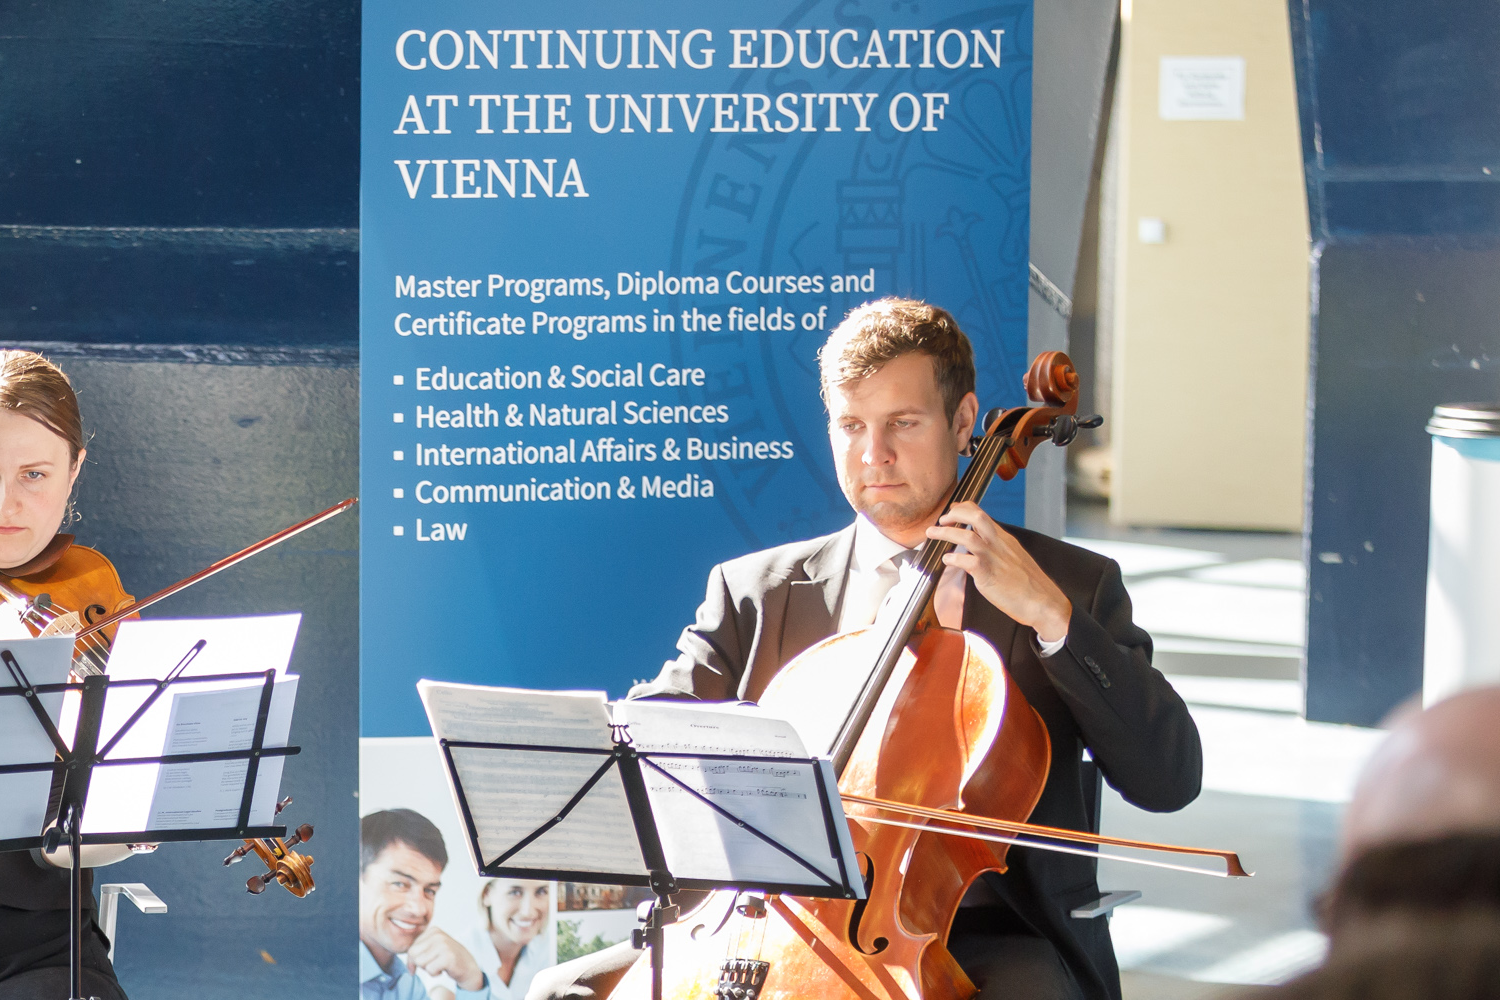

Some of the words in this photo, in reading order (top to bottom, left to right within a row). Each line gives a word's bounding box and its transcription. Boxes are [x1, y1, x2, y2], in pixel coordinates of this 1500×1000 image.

[395, 28, 716, 71] CONTINUING
[728, 28, 1005, 69] EDUCATION
[392, 94, 459, 135] AT
[468, 94, 573, 134] THE
[584, 92, 878, 134] UNIVERSITY
[888, 92, 950, 133] OF
[393, 158, 590, 200] VIENNA
[395, 274, 483, 299] Master
[487, 273, 611, 304] Programs,
[617, 270, 719, 302] Diploma
[725, 270, 825, 295] Courses
[830, 268, 875, 293] and
[394, 310, 526, 337] Certificate
[532, 311, 647, 341] Programs
[653, 308, 675, 333] in
[680, 307, 722, 333] the
[727, 306, 796, 332] fields
[801, 305, 828, 331] of
[416, 365, 542, 391] Education
[547, 365, 566, 389] &
[571, 362, 644, 389] Social
[649, 363, 706, 387] Care
[416, 402, 499, 429] Health
[504, 403, 524, 428] &
[529, 400, 618, 427] Natural
[623, 400, 729, 425] Sciences
[416, 438, 576, 467] International
[580, 437, 657, 463] Affairs
[662, 437, 681, 461] &
[687, 436, 794, 461] Business
[415, 476, 611, 505] Communication
[616, 475, 636, 500] &
[642, 473, 714, 499] Media
[416, 518, 468, 542] Law
